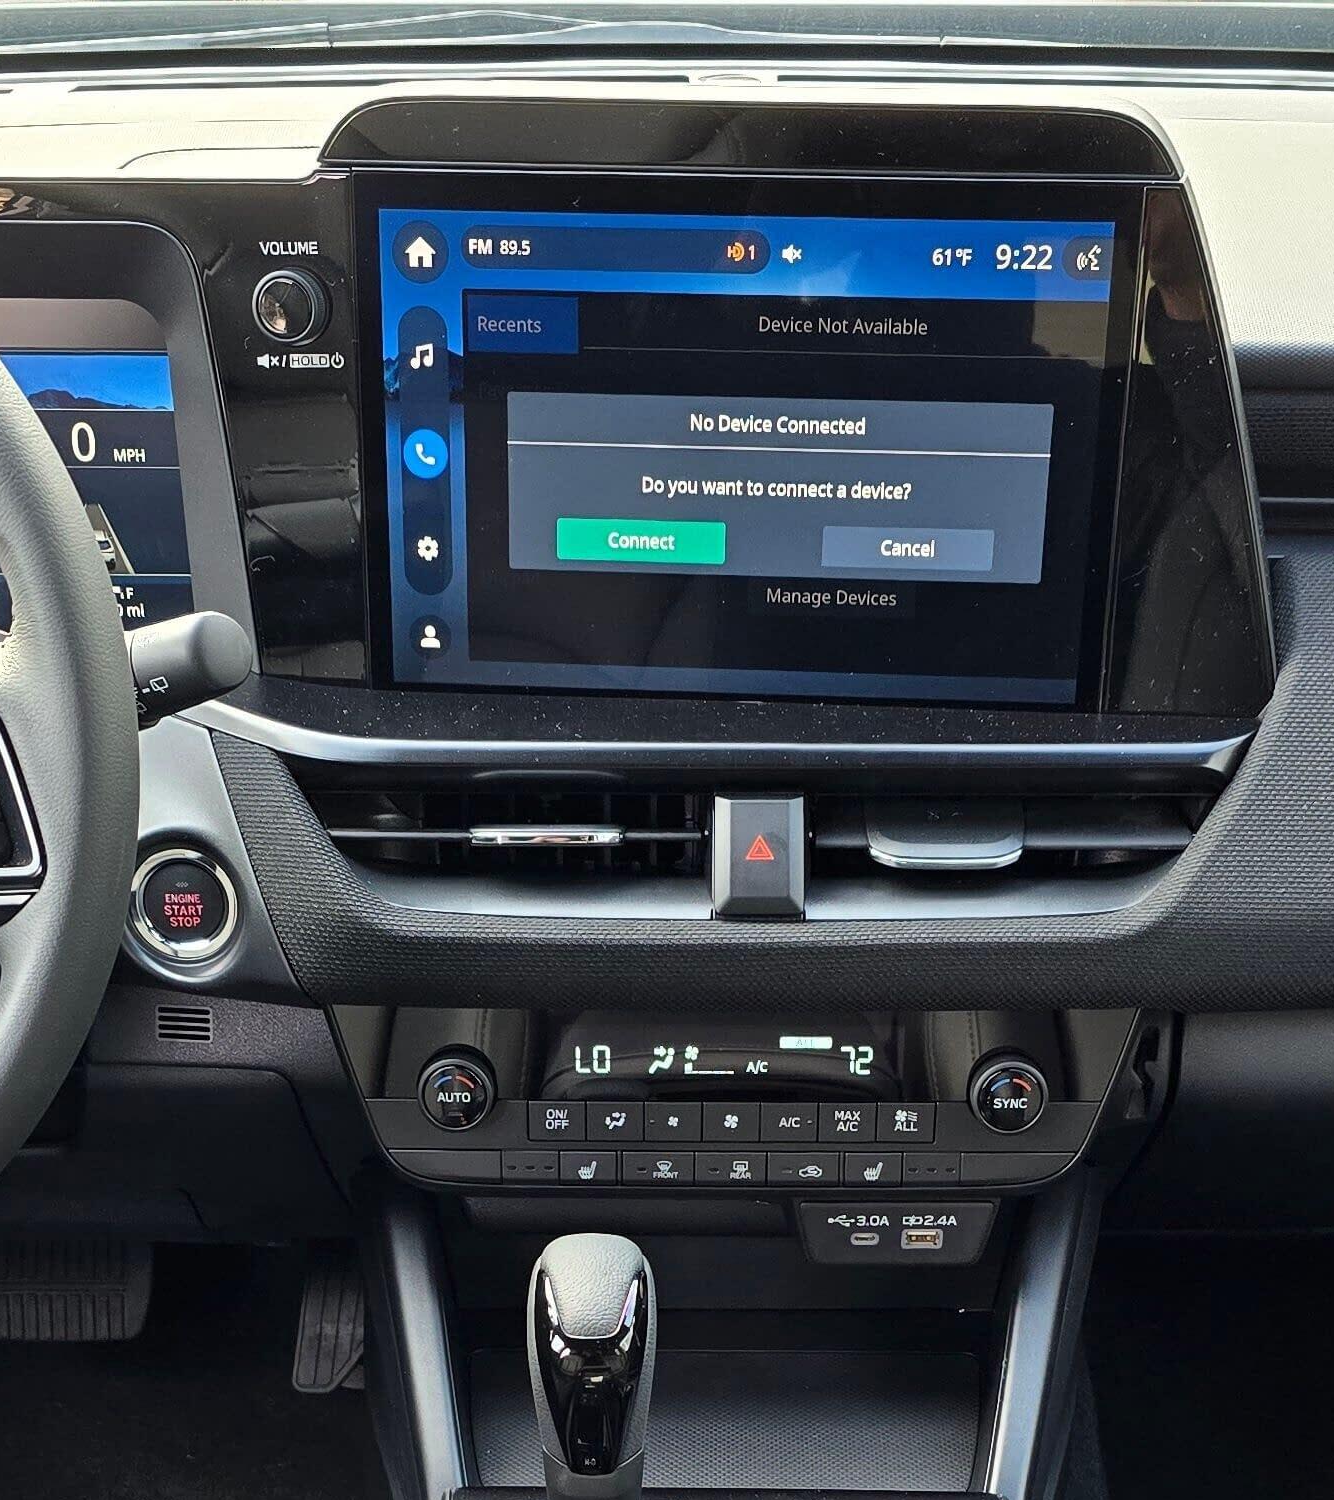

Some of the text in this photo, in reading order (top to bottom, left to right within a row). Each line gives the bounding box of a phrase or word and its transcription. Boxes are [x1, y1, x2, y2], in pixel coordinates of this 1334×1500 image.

[259, 241, 318, 255] VOLUME
[468, 240, 530, 255] FM 89.5
[933, 248, 972, 265] 61°F
[996, 244, 1052, 270] 9:22
[478, 316, 541, 333] Recents
[759, 316, 927, 335] Device Not Available
[291, 356, 328, 366] HOLD
[691, 414, 865, 435] No Device Connected
[72, 422, 145, 462] 0 MPH
[642, 476, 911, 500] Do you want to connect a device?
[608, 532, 675, 551] Connect
[881, 540, 935, 557] Cancel
[767, 588, 896, 608] Manage Devices
[165, 894, 200, 903] ENGINE
[164, 905, 203, 915] START
[170, 917, 200, 927] STOP
[575, 1045, 610, 1073] LO
[841, 1046, 873, 1075] 72
[746, 1060, 768, 1074] A/C
[437, 1092, 470, 1102] AUTO
[994, 1098, 1027, 1108] SYNC
[547, 1109, 567, 1119] ON/
[835, 1111, 860, 1121] MAX
[546, 1120, 569, 1129] OFF
[779, 1117, 800, 1127] A/C
[837, 1121, 858, 1131] A/C
[894, 1120, 917, 1131] ALL
[653, 1170, 678, 1178] FRONT
[730, 1170, 751, 1179] REAR
[856, 1216, 889, 1227] 3.0A
[924, 1216, 957, 1227] 2.4A
